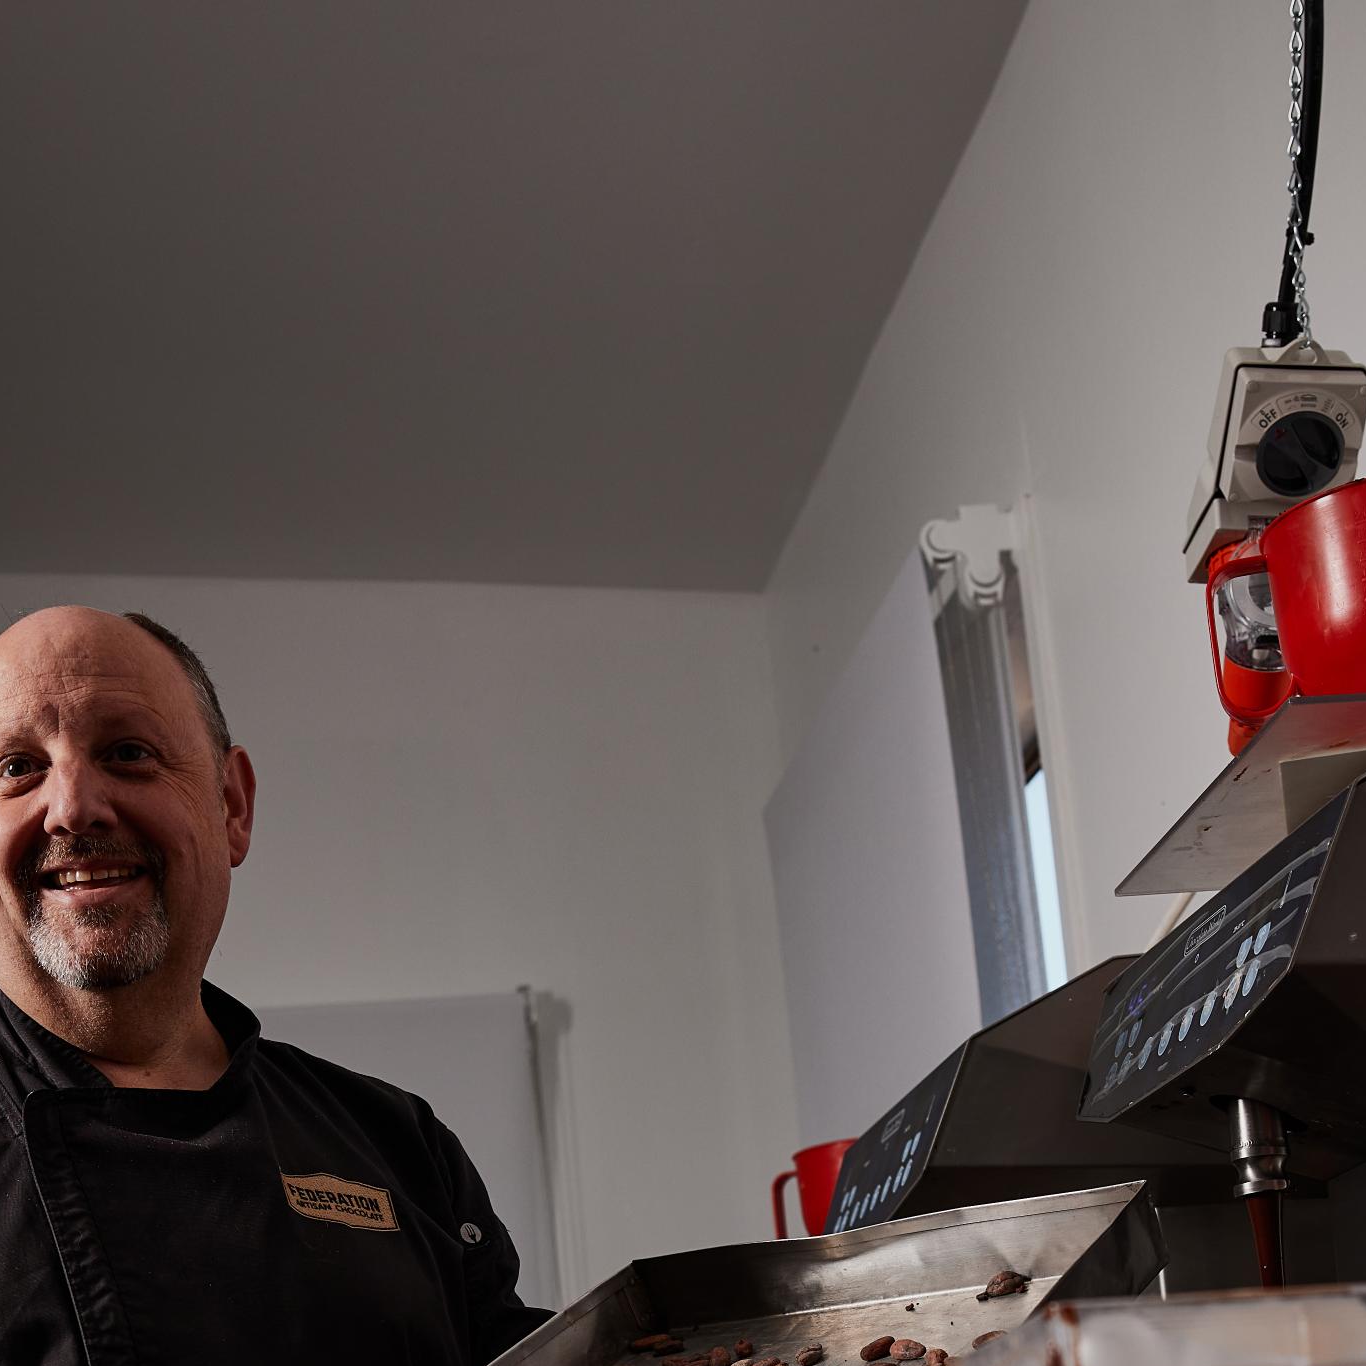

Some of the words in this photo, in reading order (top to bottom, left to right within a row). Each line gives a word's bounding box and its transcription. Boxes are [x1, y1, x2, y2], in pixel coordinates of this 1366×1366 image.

[1259, 409, 1277, 428] OFF
[1335, 413, 1349, 428] ON
[287, 1183, 381, 1213] FEDERATION
[296, 1200, 333, 1212] ARTISAN
[336, 1204, 385, 1222] CHOCOLATE
